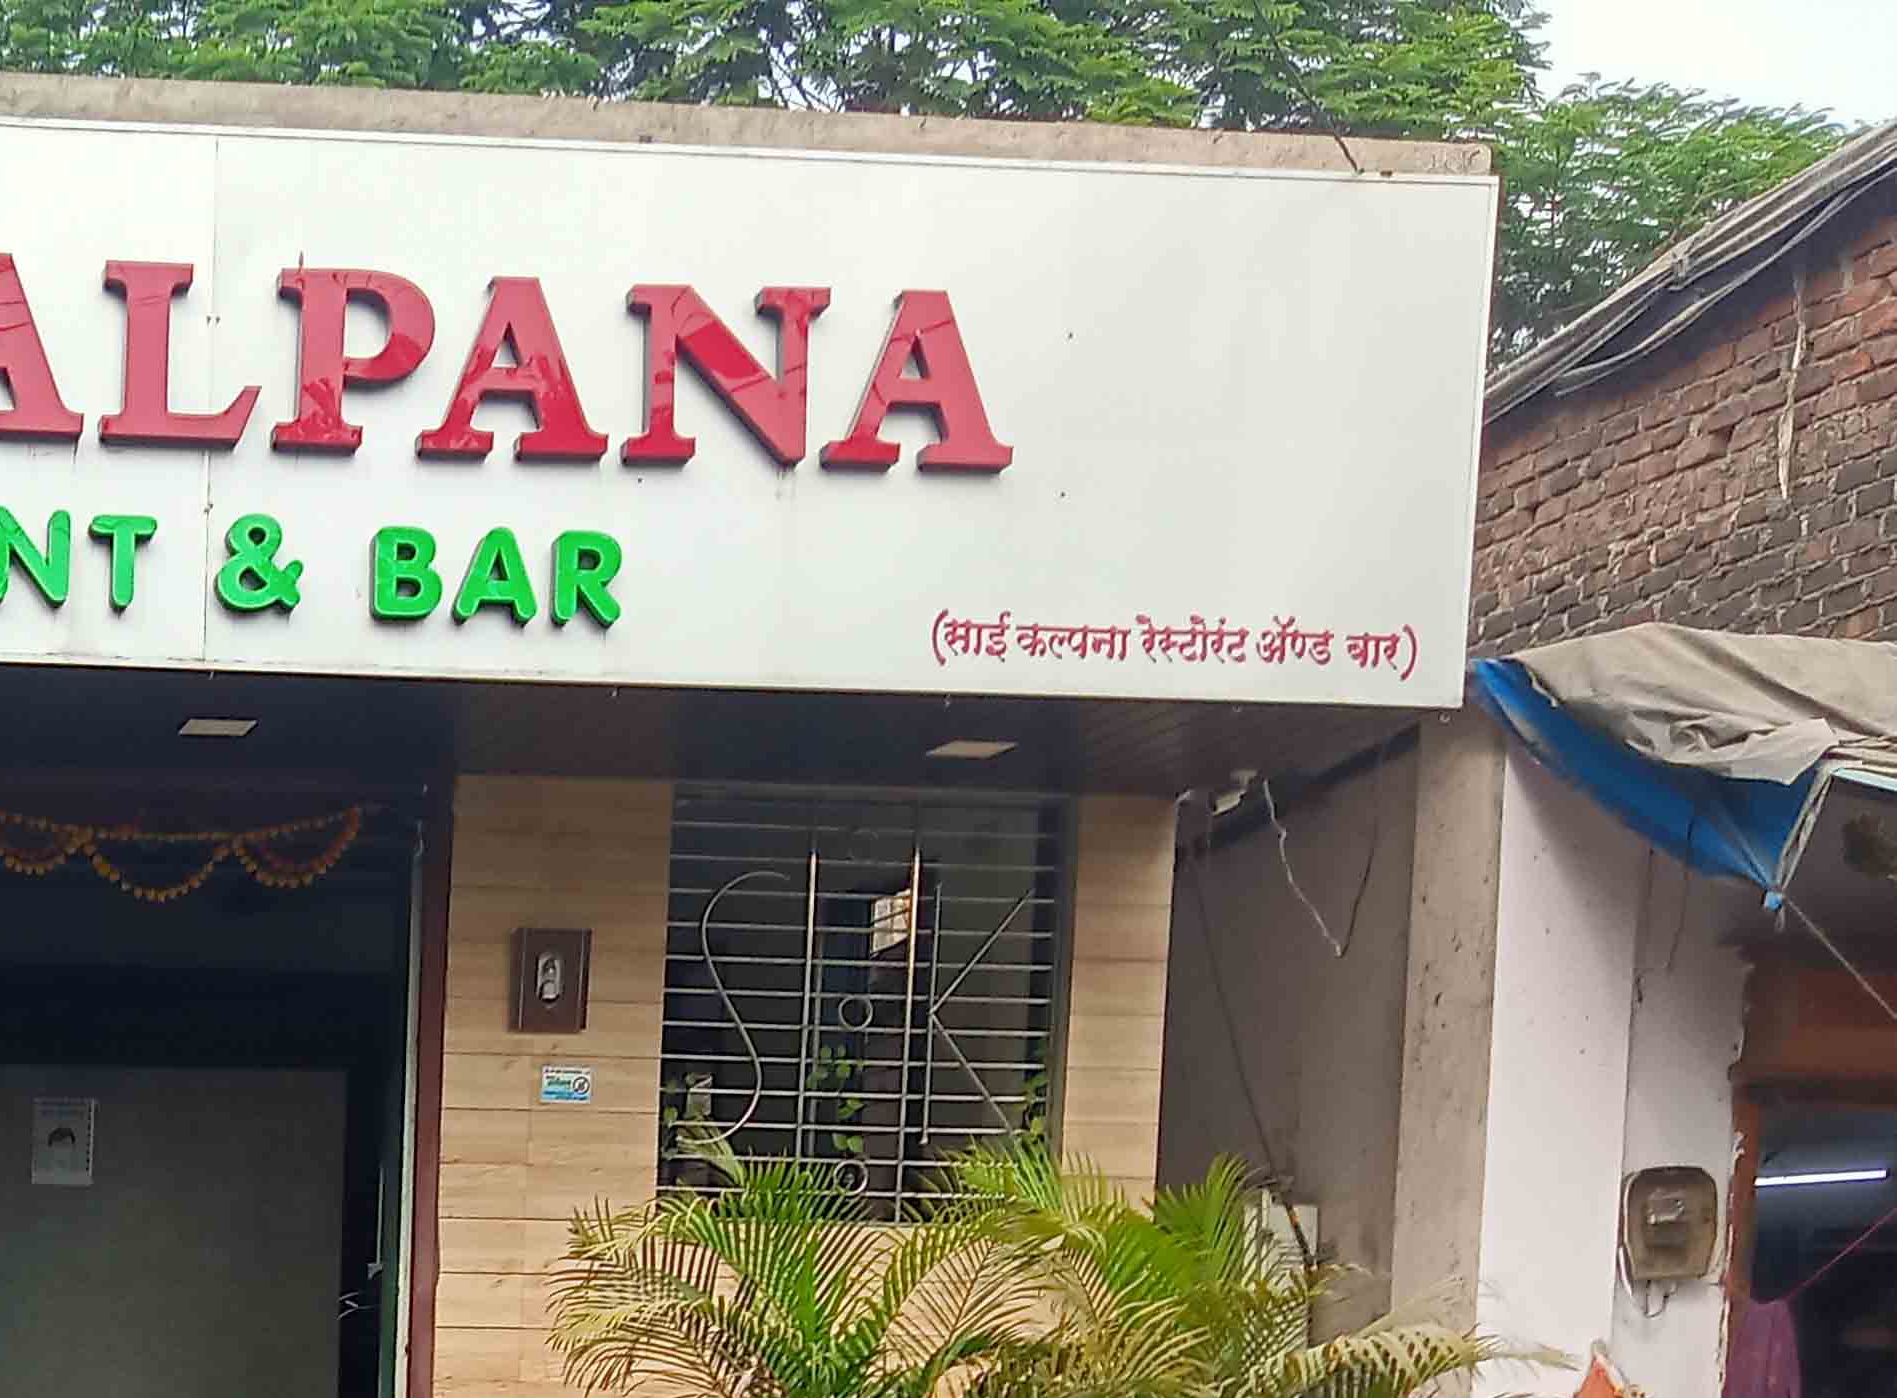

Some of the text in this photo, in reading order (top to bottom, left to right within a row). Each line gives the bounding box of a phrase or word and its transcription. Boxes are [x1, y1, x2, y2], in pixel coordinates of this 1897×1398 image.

[216, 513, 305, 615] &
[370, 525, 624, 627] BAR
[931, 609, 1011, 665] (साई
[1015, 622, 1132, 662] कल्पना
